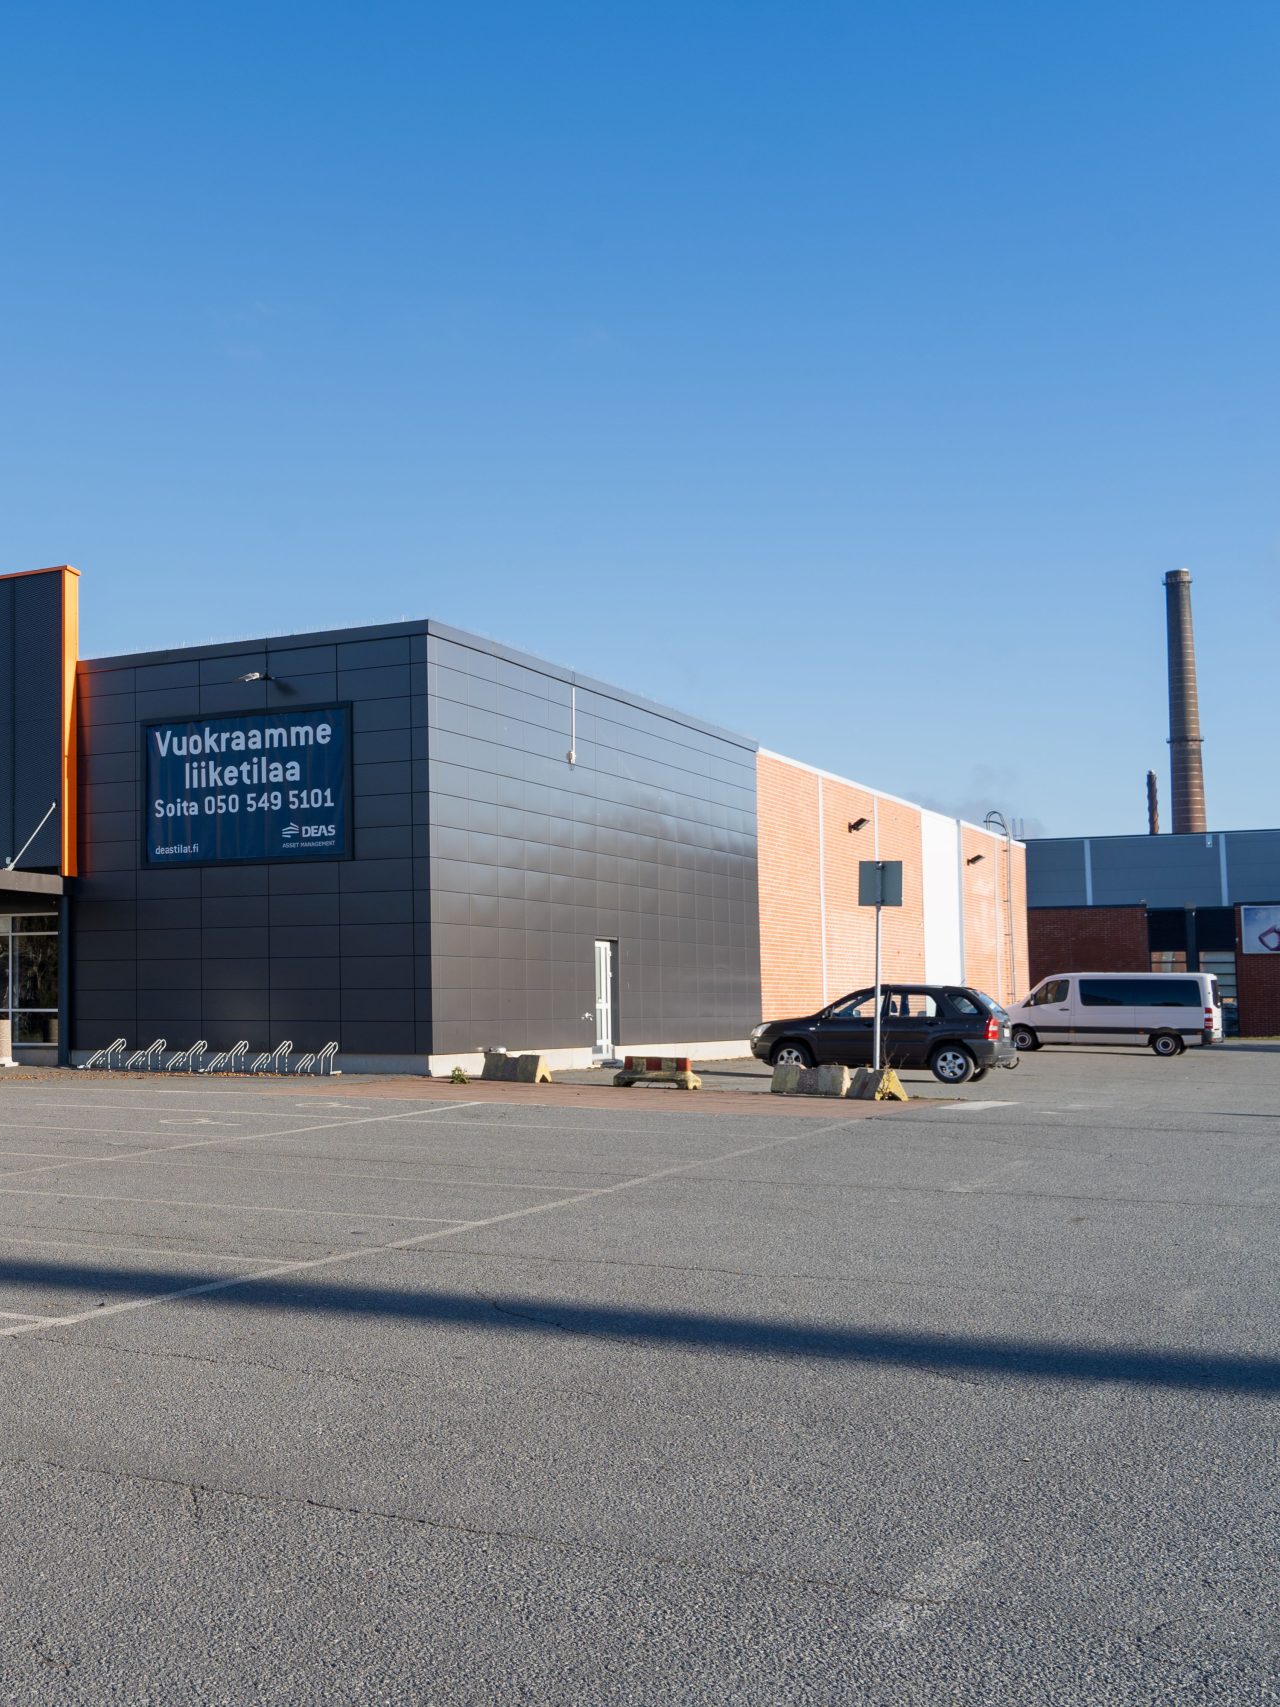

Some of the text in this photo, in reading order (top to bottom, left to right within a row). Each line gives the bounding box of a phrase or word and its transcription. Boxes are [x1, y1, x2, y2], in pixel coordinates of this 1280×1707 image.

[155, 723, 332, 757] Vuokraamme
[185, 757, 301, 789] liiketilaa
[154, 788, 335, 818] Soita 050 549 5101
[302, 825, 336, 838] DEAS
[155, 843, 199, 855] deastilat.fi
[300, 840, 335, 848] MANAGEMENT
